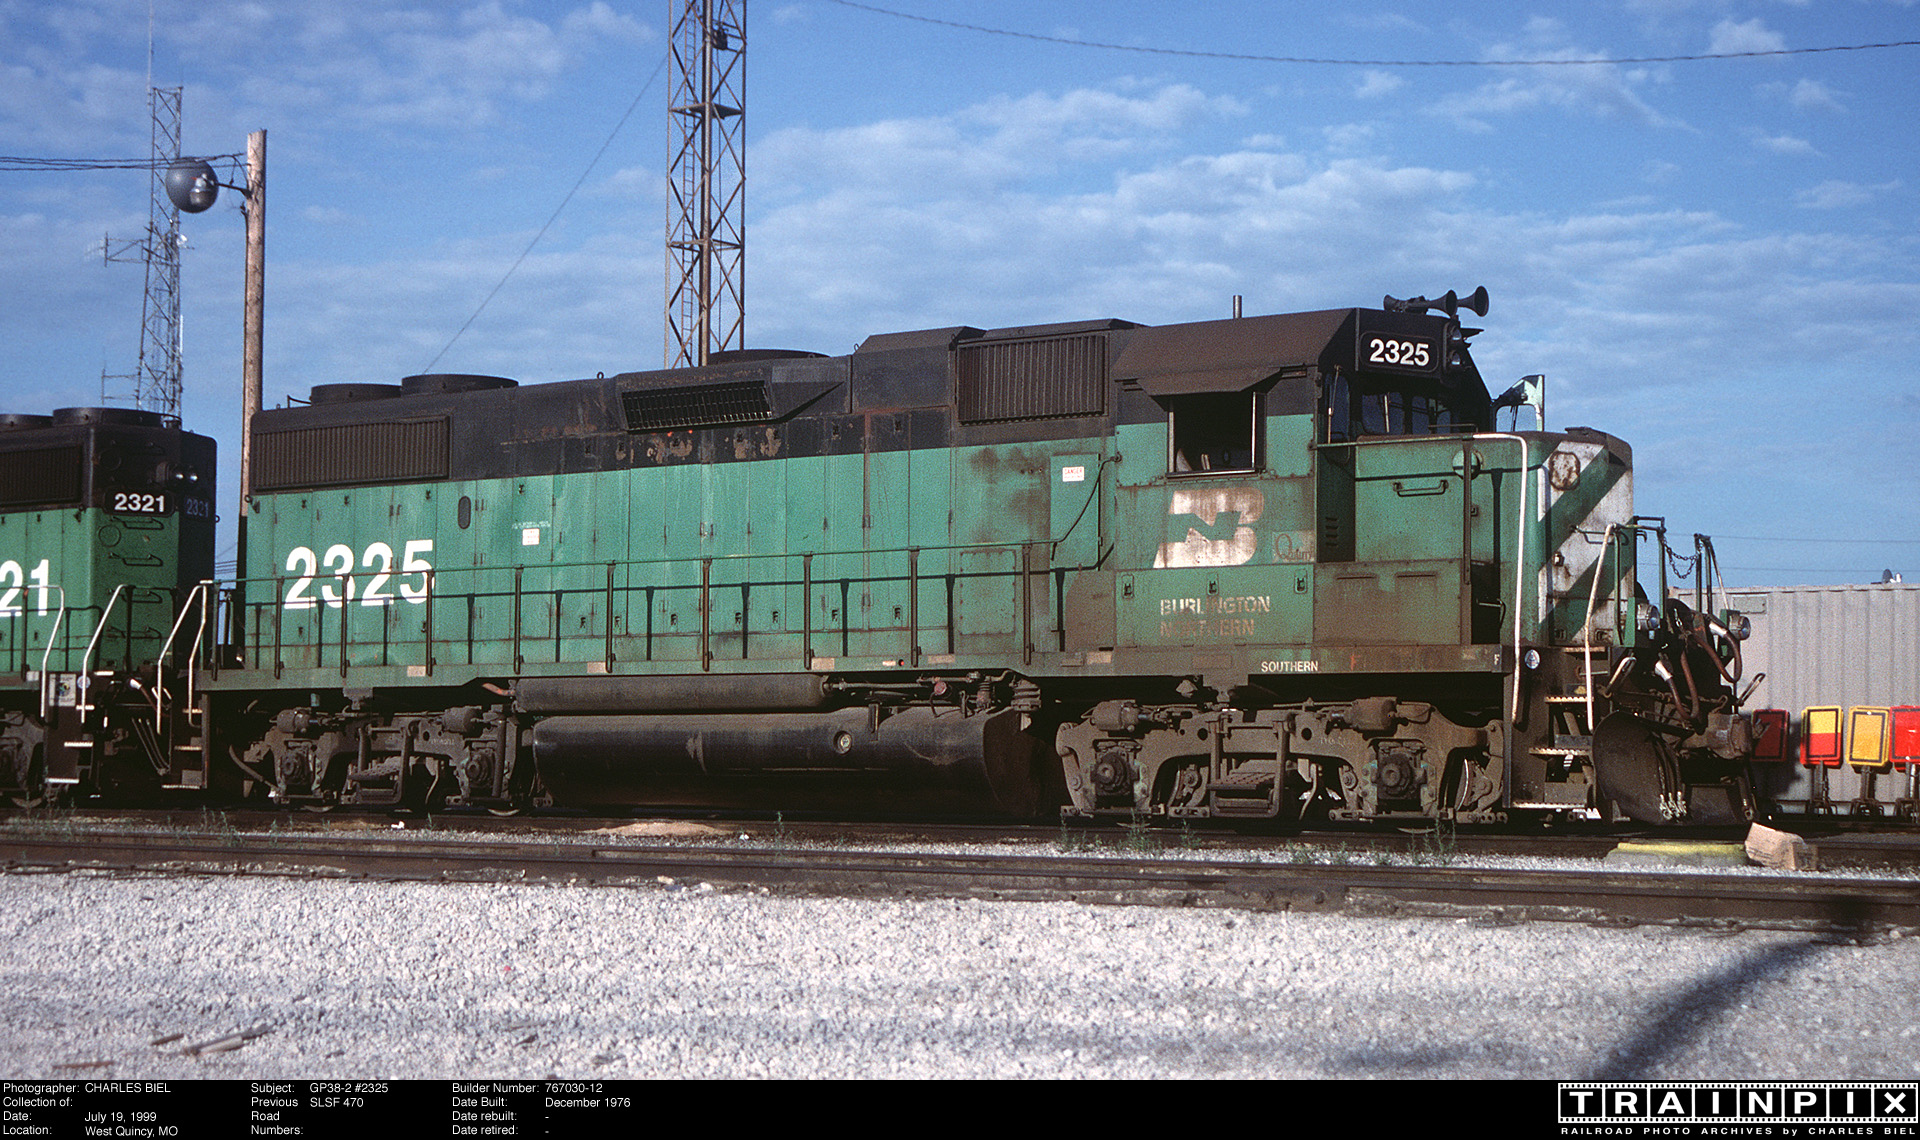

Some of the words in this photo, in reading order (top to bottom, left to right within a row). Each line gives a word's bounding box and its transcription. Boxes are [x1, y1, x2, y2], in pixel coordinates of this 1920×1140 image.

[1369, 338, 1430, 367] 2325
[114, 493, 165, 512] 2321
[186, 498, 209, 518] 2321
[284, 539, 435, 610] 2325
[0, 559, 49, 617] 21
[1160, 596, 1270, 616] BURLINGTON
[1160, 619, 1255, 638] NORTHERN
[1261, 660, 1319, 672] SOUTHERN
[1493, 653, 1500, 665] F
